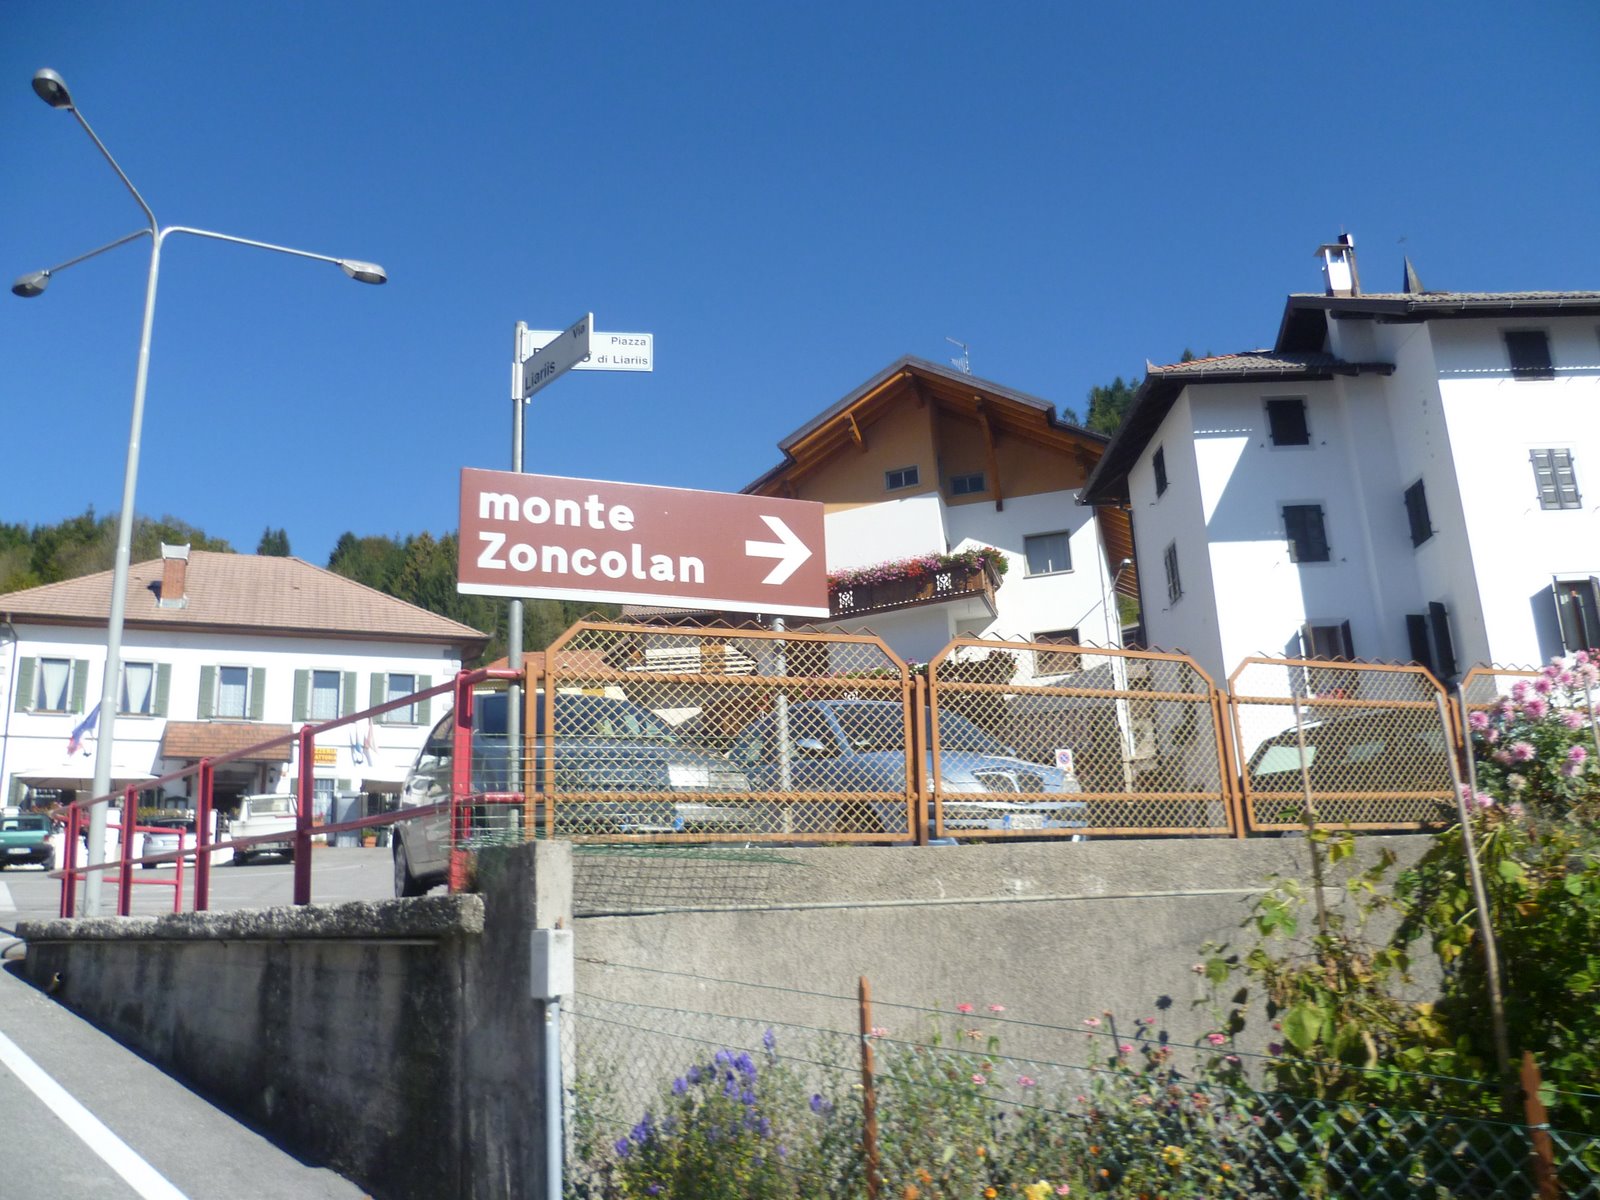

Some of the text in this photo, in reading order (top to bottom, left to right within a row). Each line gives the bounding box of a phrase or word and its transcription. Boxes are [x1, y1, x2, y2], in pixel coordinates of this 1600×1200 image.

[572, 324, 585, 339] Via
[611, 336, 647, 346] Piazza
[597, 354, 608, 364] di
[613, 355, 648, 365] Liariis
[525, 361, 555, 391] Liariis
[478, 491, 635, 532] monte
[477, 531, 705, 584] Zoncolan
